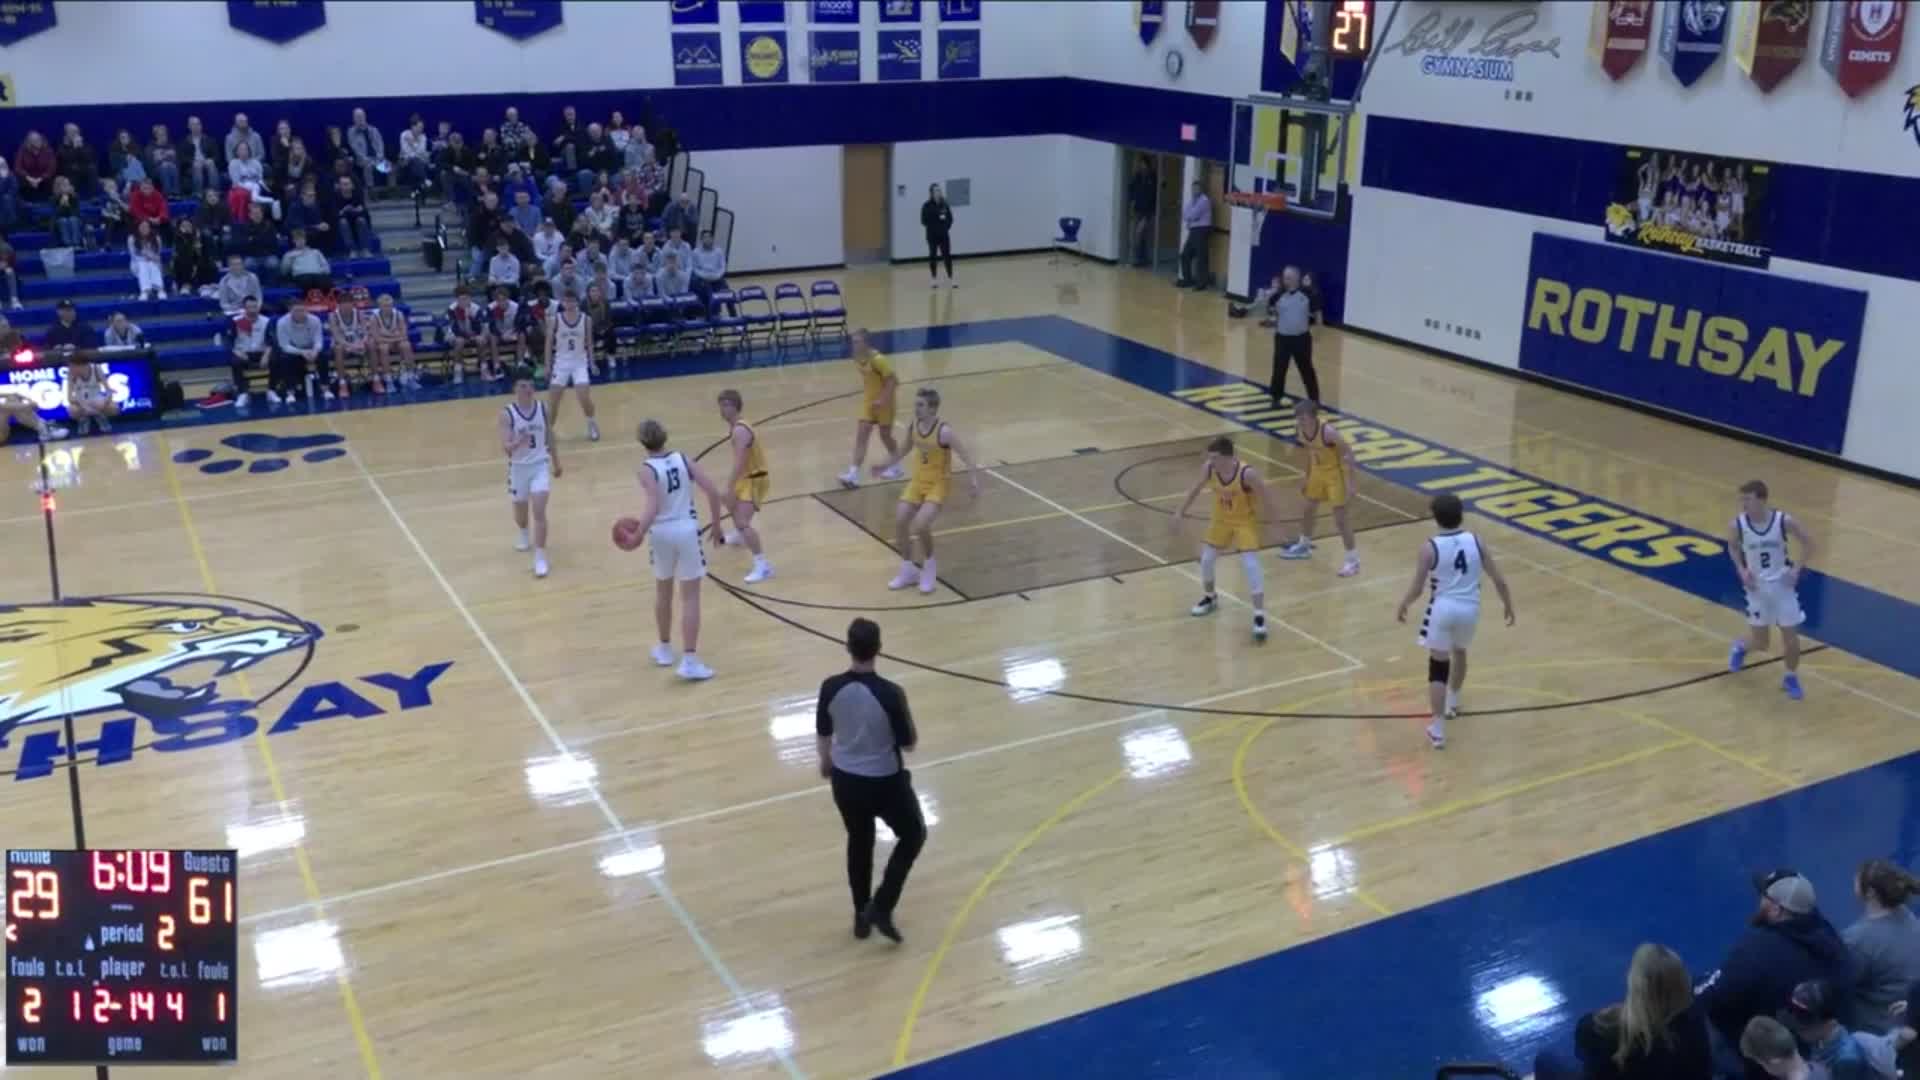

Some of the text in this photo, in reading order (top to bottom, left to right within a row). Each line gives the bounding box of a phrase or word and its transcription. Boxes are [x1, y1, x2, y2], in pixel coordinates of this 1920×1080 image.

[1333, 11, 1367, 50] 27
[1421, 55, 1513, 81] GYMNASIUM
[1695, 237, 1762, 258] BASKETBALL
[1527, 277, 1845, 398] ROTHSAY
[9, 369, 56, 383] HOME
[666, 467, 681, 494] 13
[1417, 466, 1725, 567] TIGERS
[1454, 548, 1468, 576] 4
[1760, 551, 1771, 569] 2
[0, 660, 455, 782] HSAY
